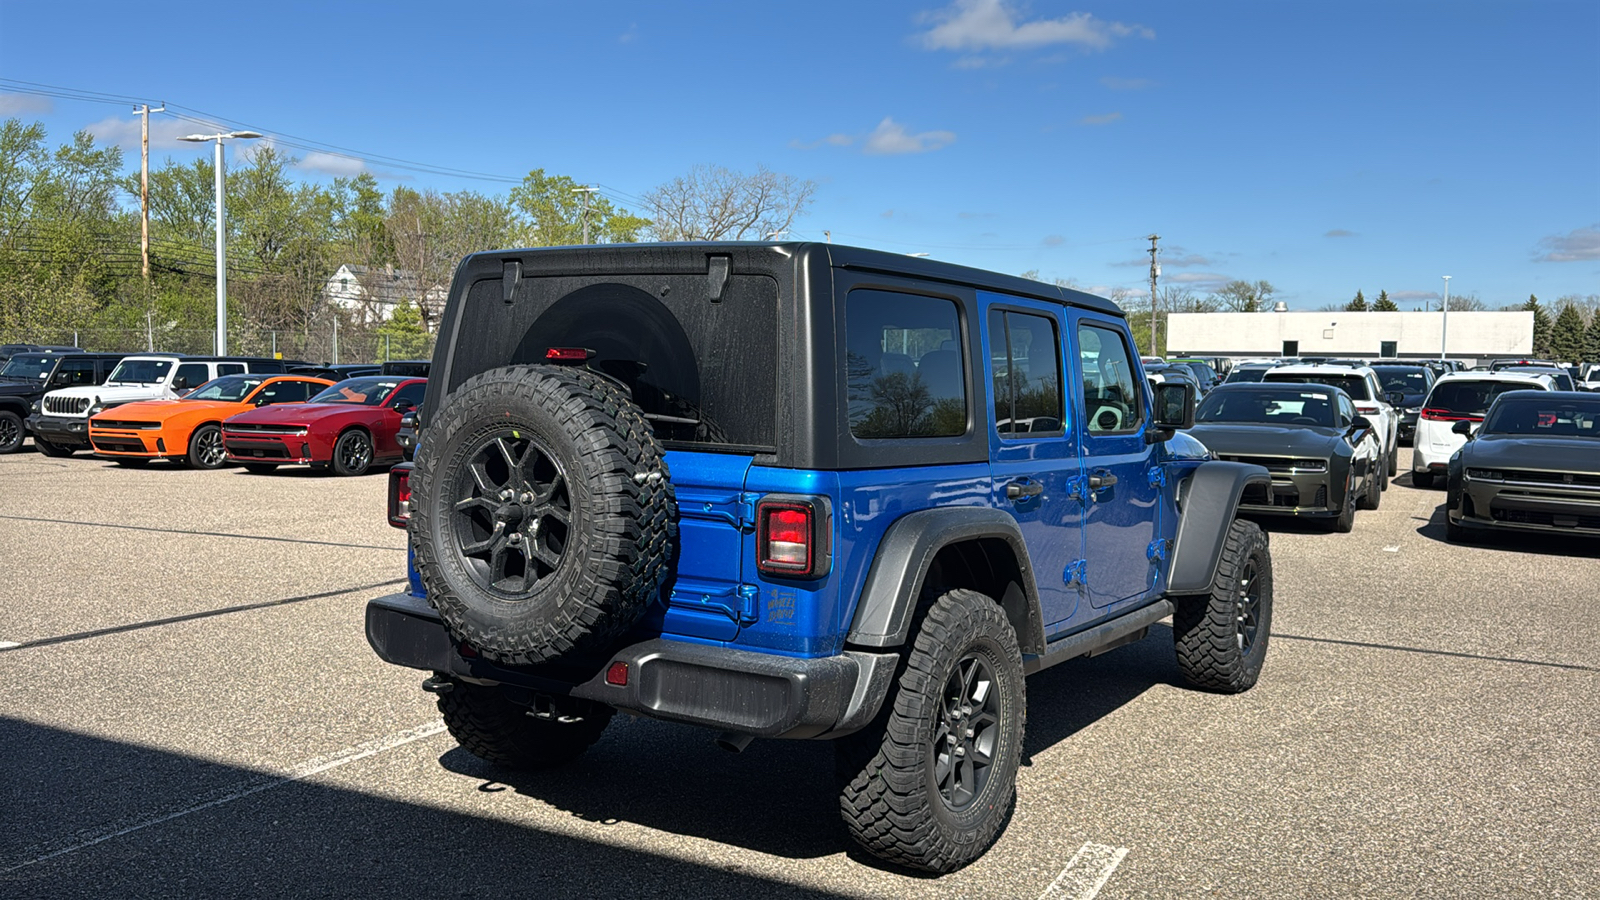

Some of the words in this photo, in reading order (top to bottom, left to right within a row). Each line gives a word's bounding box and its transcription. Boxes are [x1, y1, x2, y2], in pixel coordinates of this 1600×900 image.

[419, 456, 469, 615] WILDPEAK
[556, 456, 590, 607] FALKEN
[768, 597, 795, 609] WHEEL
